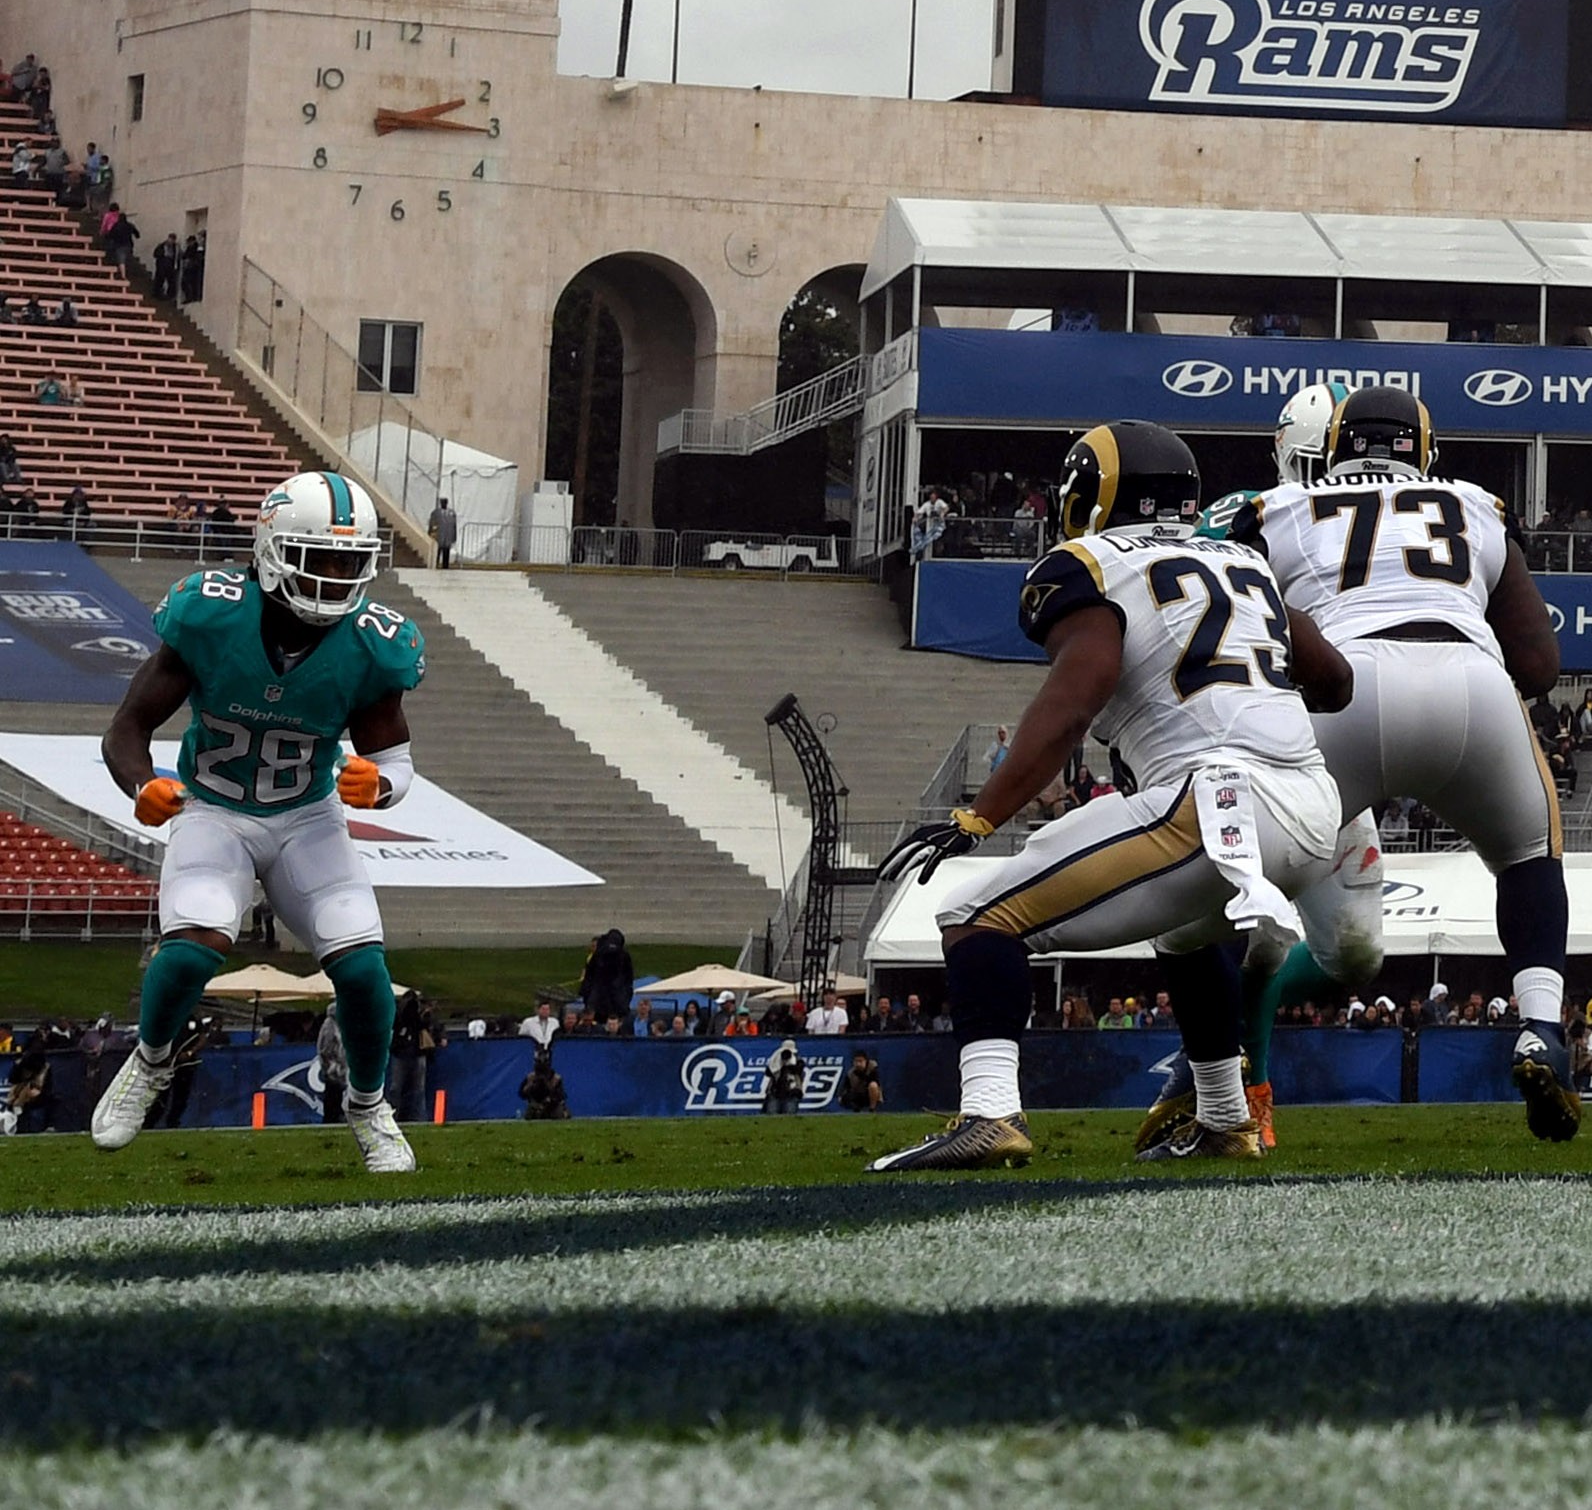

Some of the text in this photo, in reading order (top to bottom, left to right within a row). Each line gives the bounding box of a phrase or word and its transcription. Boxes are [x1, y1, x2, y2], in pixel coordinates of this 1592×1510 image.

[1280, 0, 1480, 25] LOS ANGELES
[355, 30, 371, 50] 11
[401, 23, 423, 44] 12
[316, 68, 344, 90] 10
[479, 81, 491, 102] 2
[302, 102, 316, 125] 9
[487, 118, 500, 138] 3
[313, 147, 327, 168] 8
[472, 160, 484, 179] 4
[349, 184, 362, 205] 7
[437, 190, 452, 212] 5
[390, 200, 405, 221] 6
[1309, 489, 1473, 593] 73
[201, 568, 245, 602] 28
[1, 595, 81, 607] BUD
[5, 606, 108, 620] LIGHT
[357, 601, 406, 640] 28
[1146, 553, 1299, 703] 23
[229, 702, 304, 727] Dolphins
[194, 711, 322, 805] 28
[378, 847, 510, 861] Airlines
[681, 1043, 843, 1110] Ras
